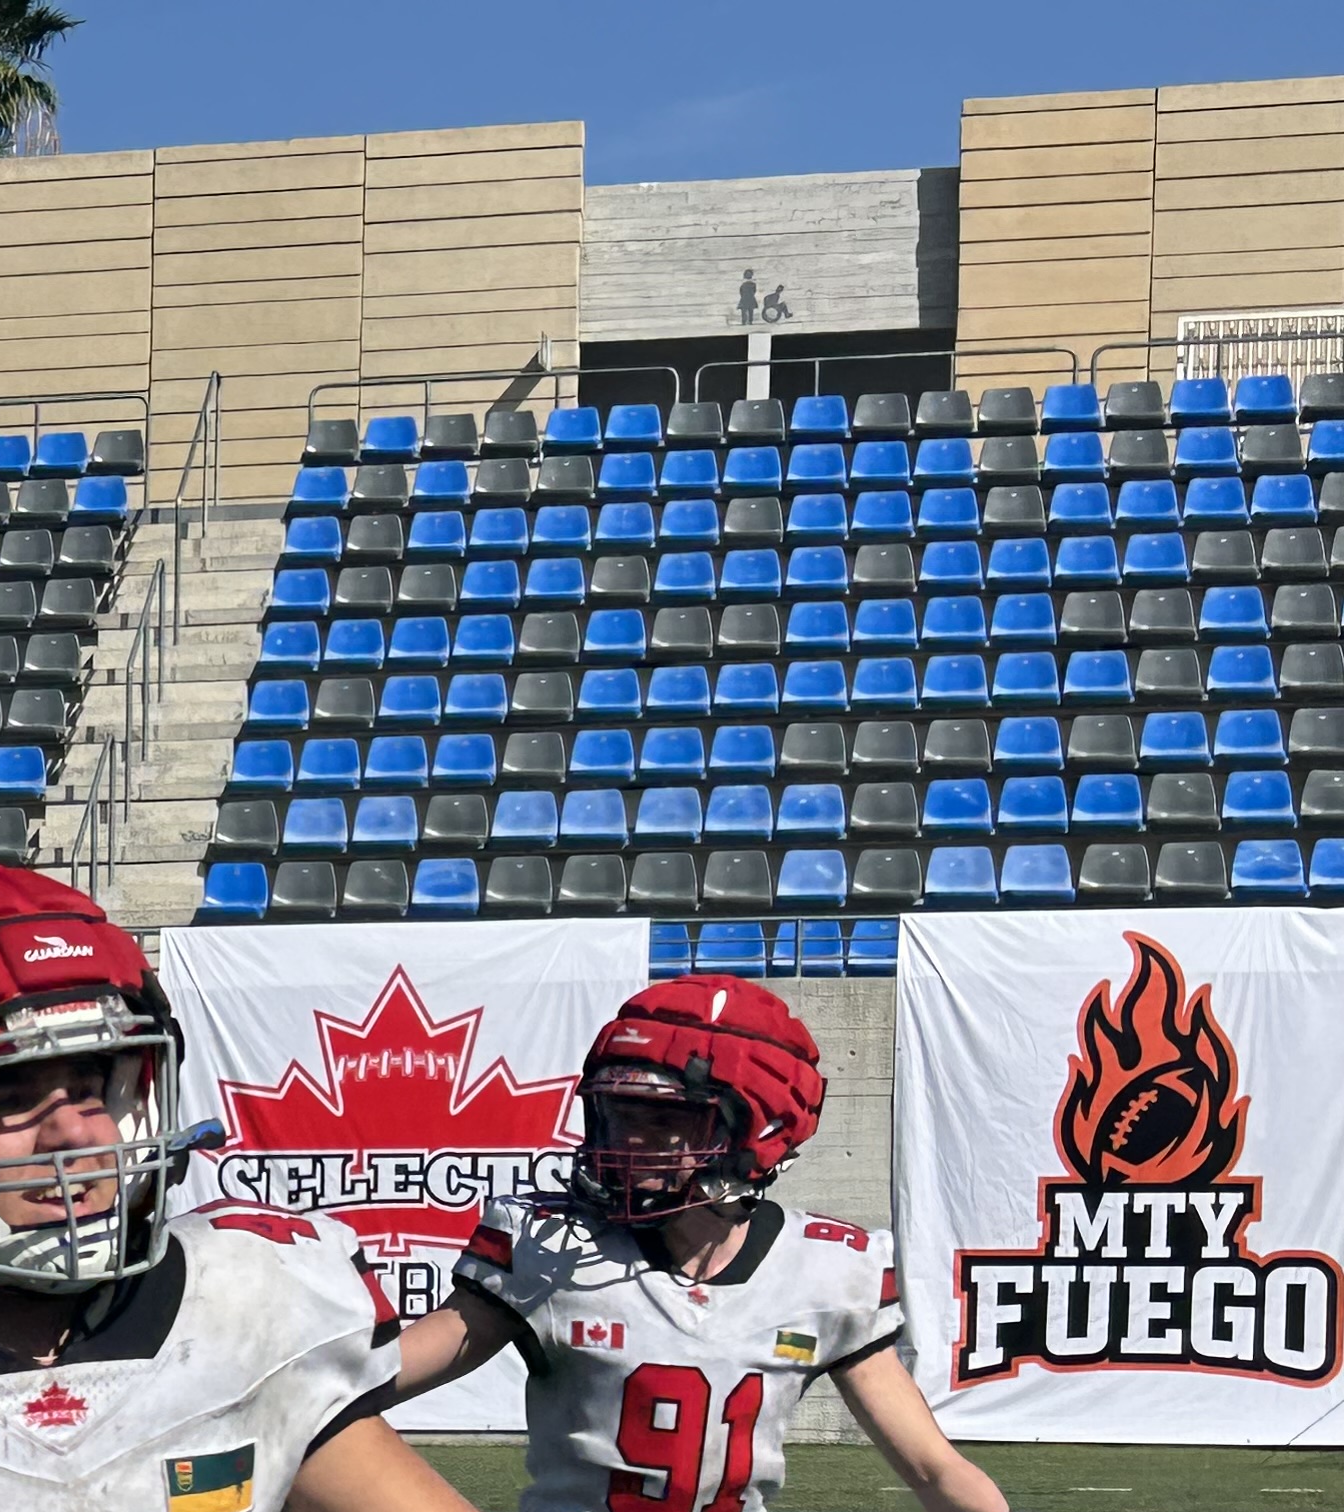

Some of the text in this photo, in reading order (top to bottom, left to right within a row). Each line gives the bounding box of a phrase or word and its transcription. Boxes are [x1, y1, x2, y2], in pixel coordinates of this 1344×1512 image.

[217, 1152, 576, 1212] SELECTS
[1054, 1192, 1244, 1259] MTY
[967, 1265, 1328, 1371] FUEGO
